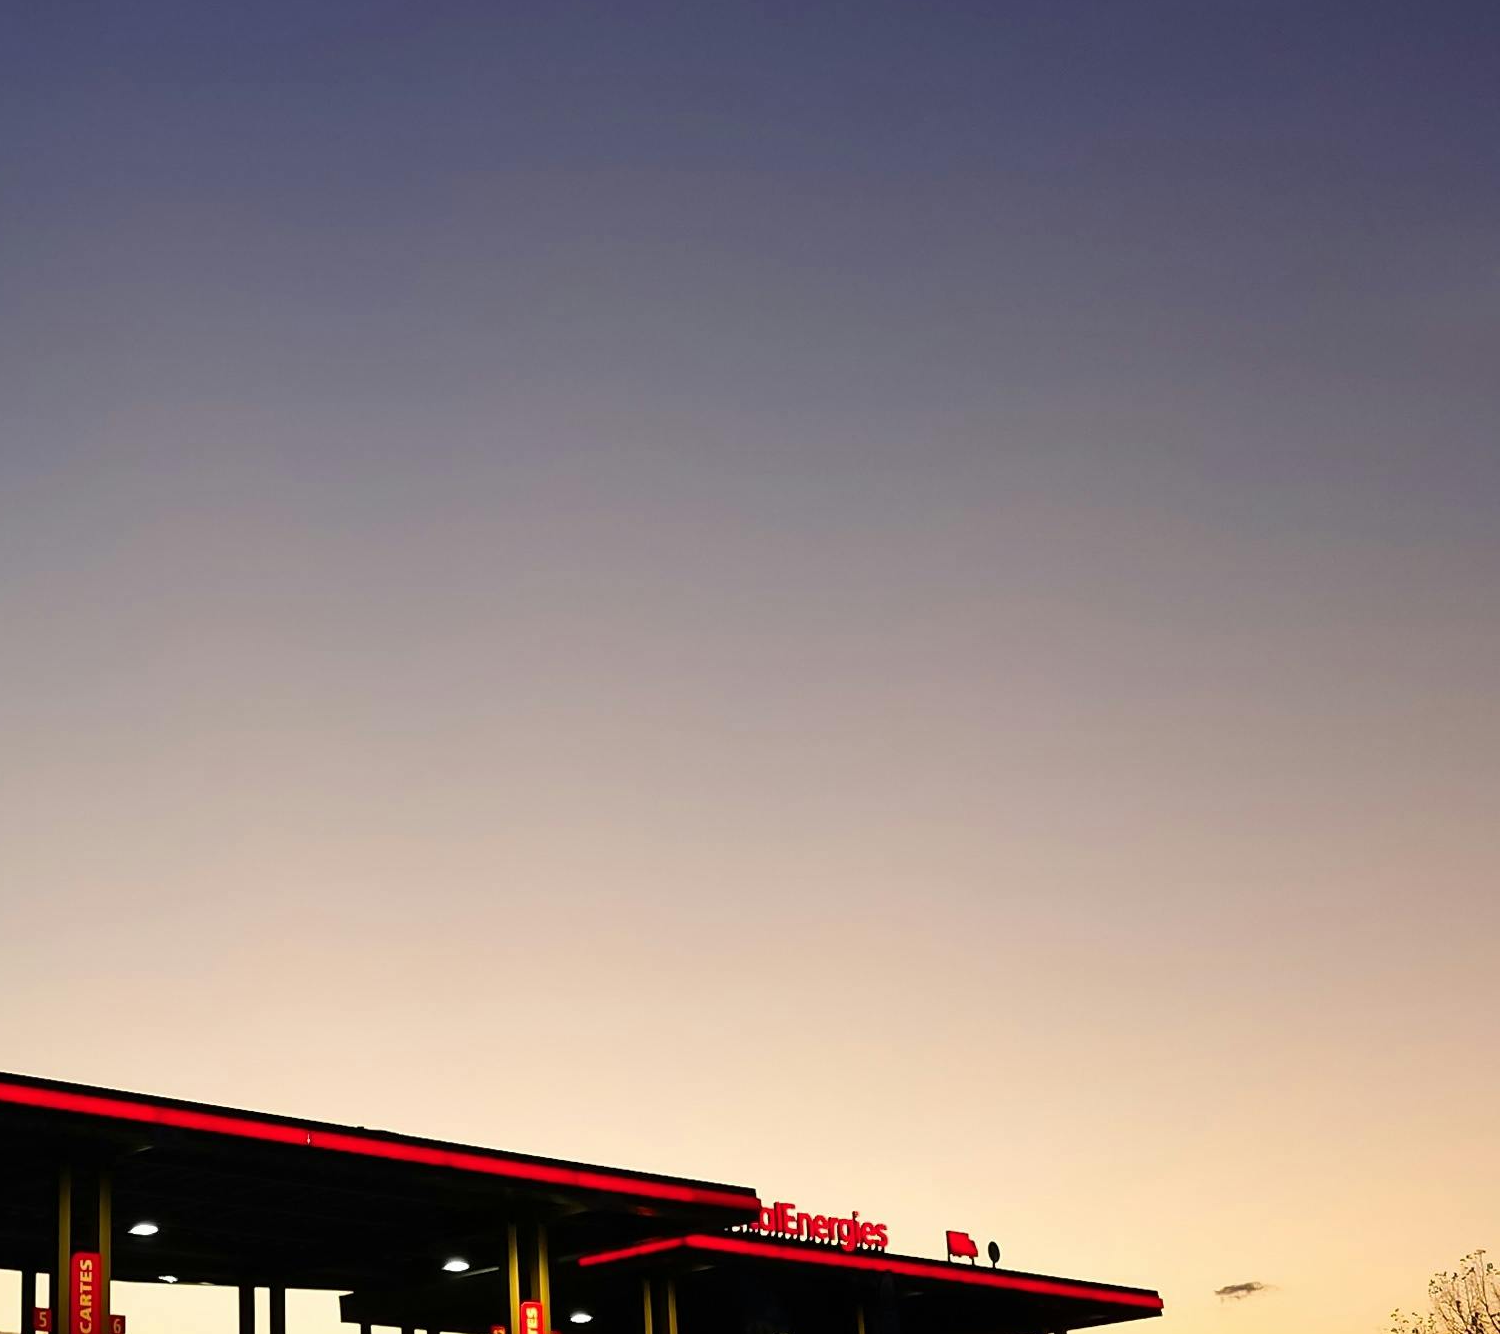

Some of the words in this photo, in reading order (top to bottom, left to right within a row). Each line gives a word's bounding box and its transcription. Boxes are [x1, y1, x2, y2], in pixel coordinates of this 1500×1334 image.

[754, 1201, 888, 1252] alEnergies
[79, 1259, 93, 1334] CARTES
[39, 1311, 48, 1328] 5
[113, 1318, 122, 1334] 6
